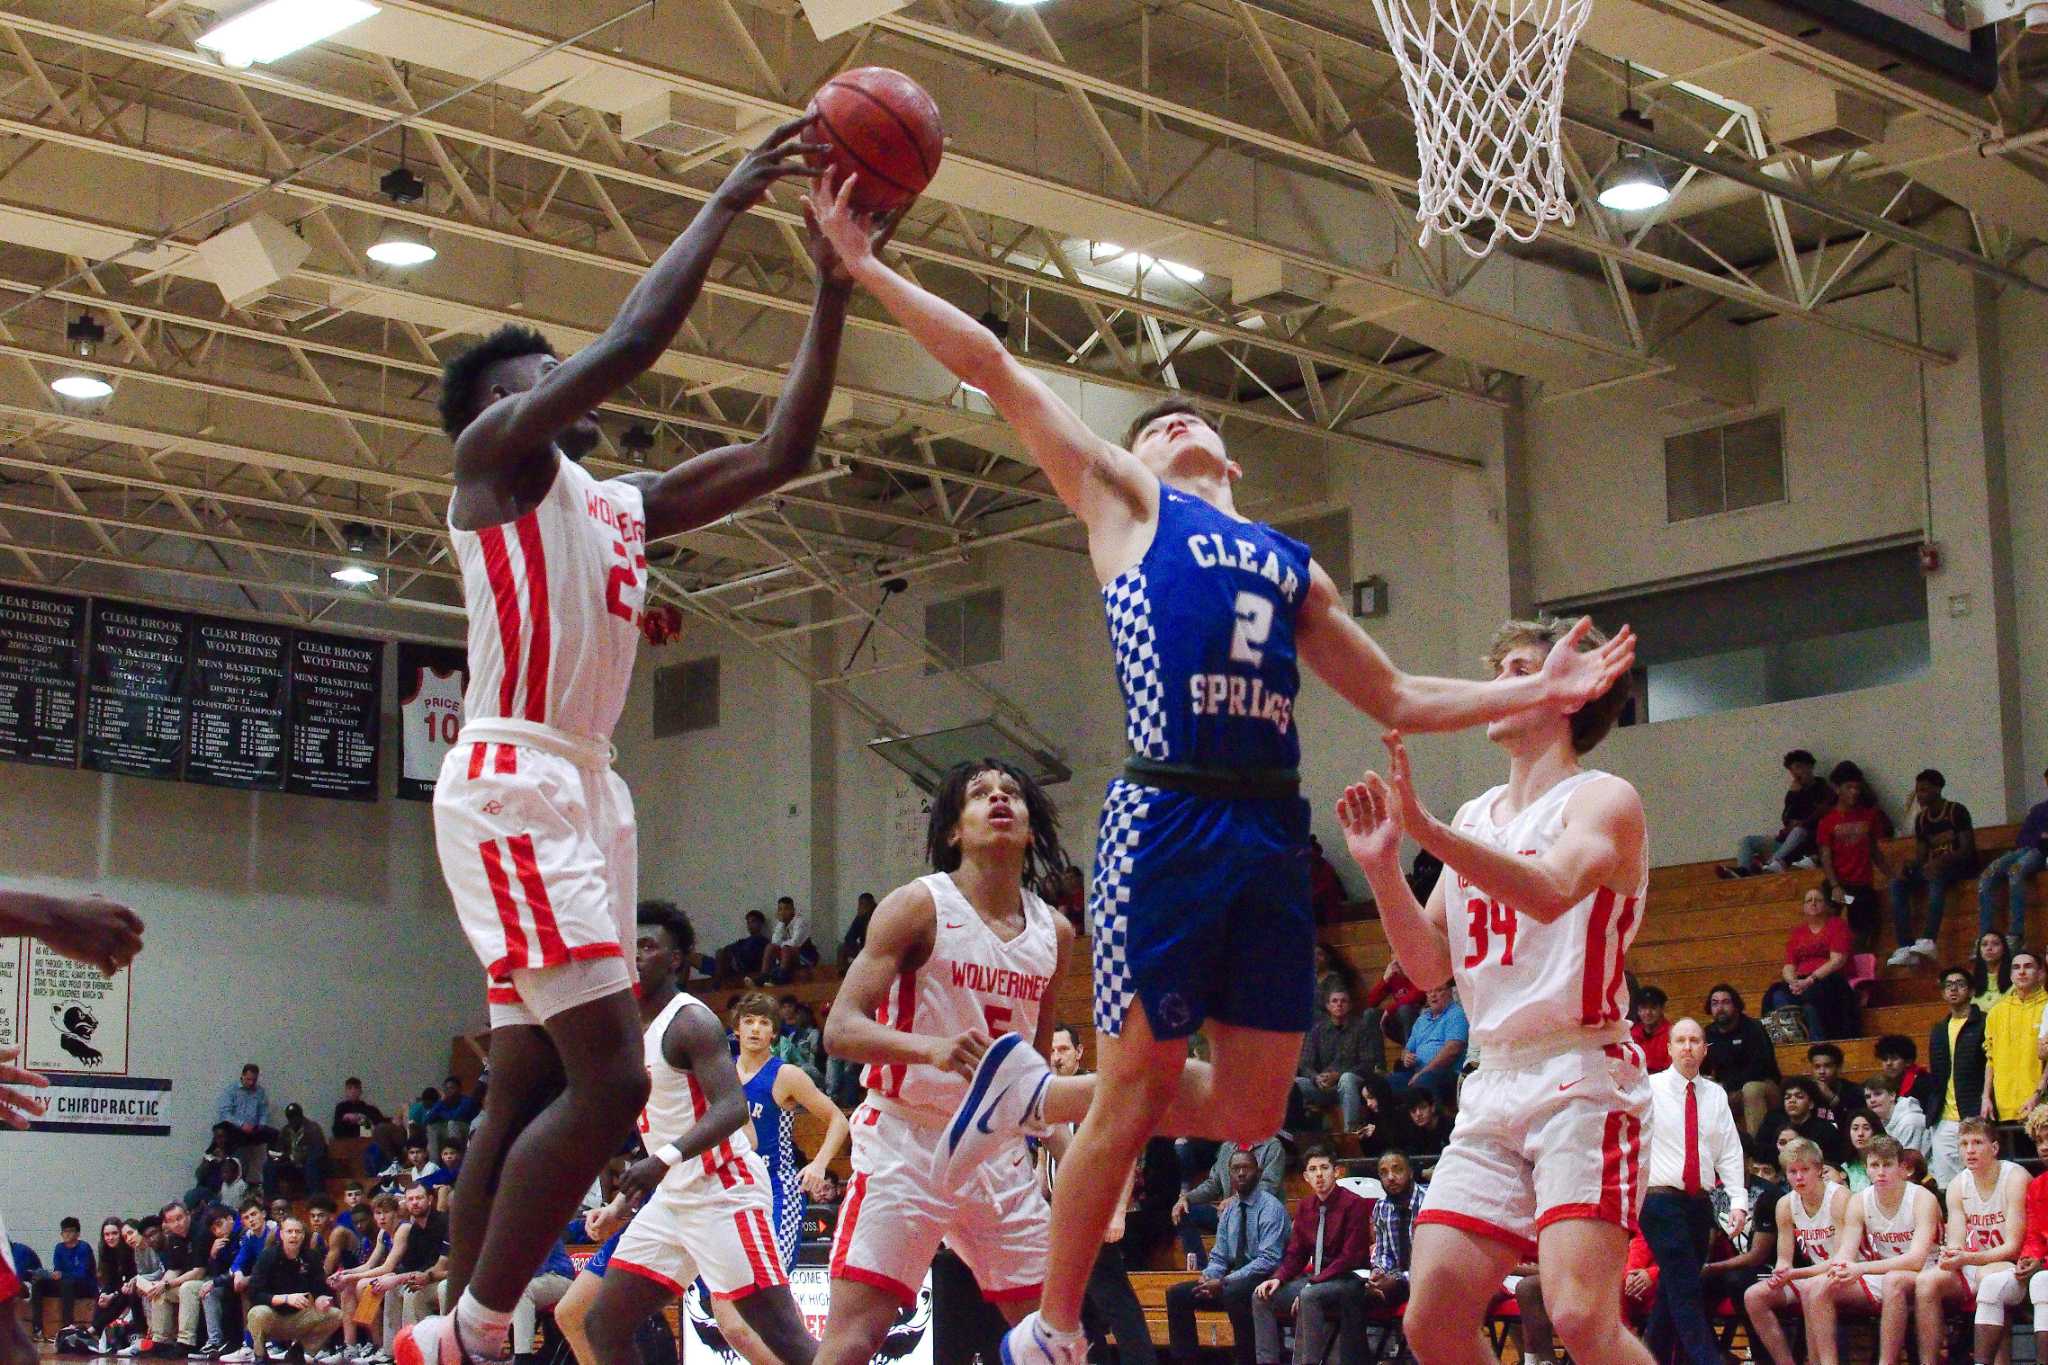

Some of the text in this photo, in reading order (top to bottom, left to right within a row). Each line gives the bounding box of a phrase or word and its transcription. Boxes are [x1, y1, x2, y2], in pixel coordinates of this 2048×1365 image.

[1187, 533, 1300, 603] CLEAR
[0, 595, 74, 615] LEAR BROOK
[101, 611, 184, 633] CLEAR BROOK
[1230, 590, 1274, 668] 2
[106, 625, 179, 646] WOLVERINES
[201, 627, 282, 647] CLEAR BROOK
[126, 648, 184, 664] BASKETBALL
[205, 640, 279, 658] WOLVERINES
[298, 641, 373, 661] CLEAR BROOK
[197, 658, 284, 678] MENS BASKETBALL
[302, 655, 369, 674] WOLVERINES
[293, 672, 374, 691] MENS BASKETBALL
[240, 705, 283, 716] CHAMPIONS
[424, 697, 460, 712] PRICE
[424, 711, 460, 745] 10
[419, 783, 435, 791] 199
[1464, 898, 1518, 969] 34
[58, 1097, 160, 1116] CHIROPRACTIC
[791, 1271, 821, 1285] COME
